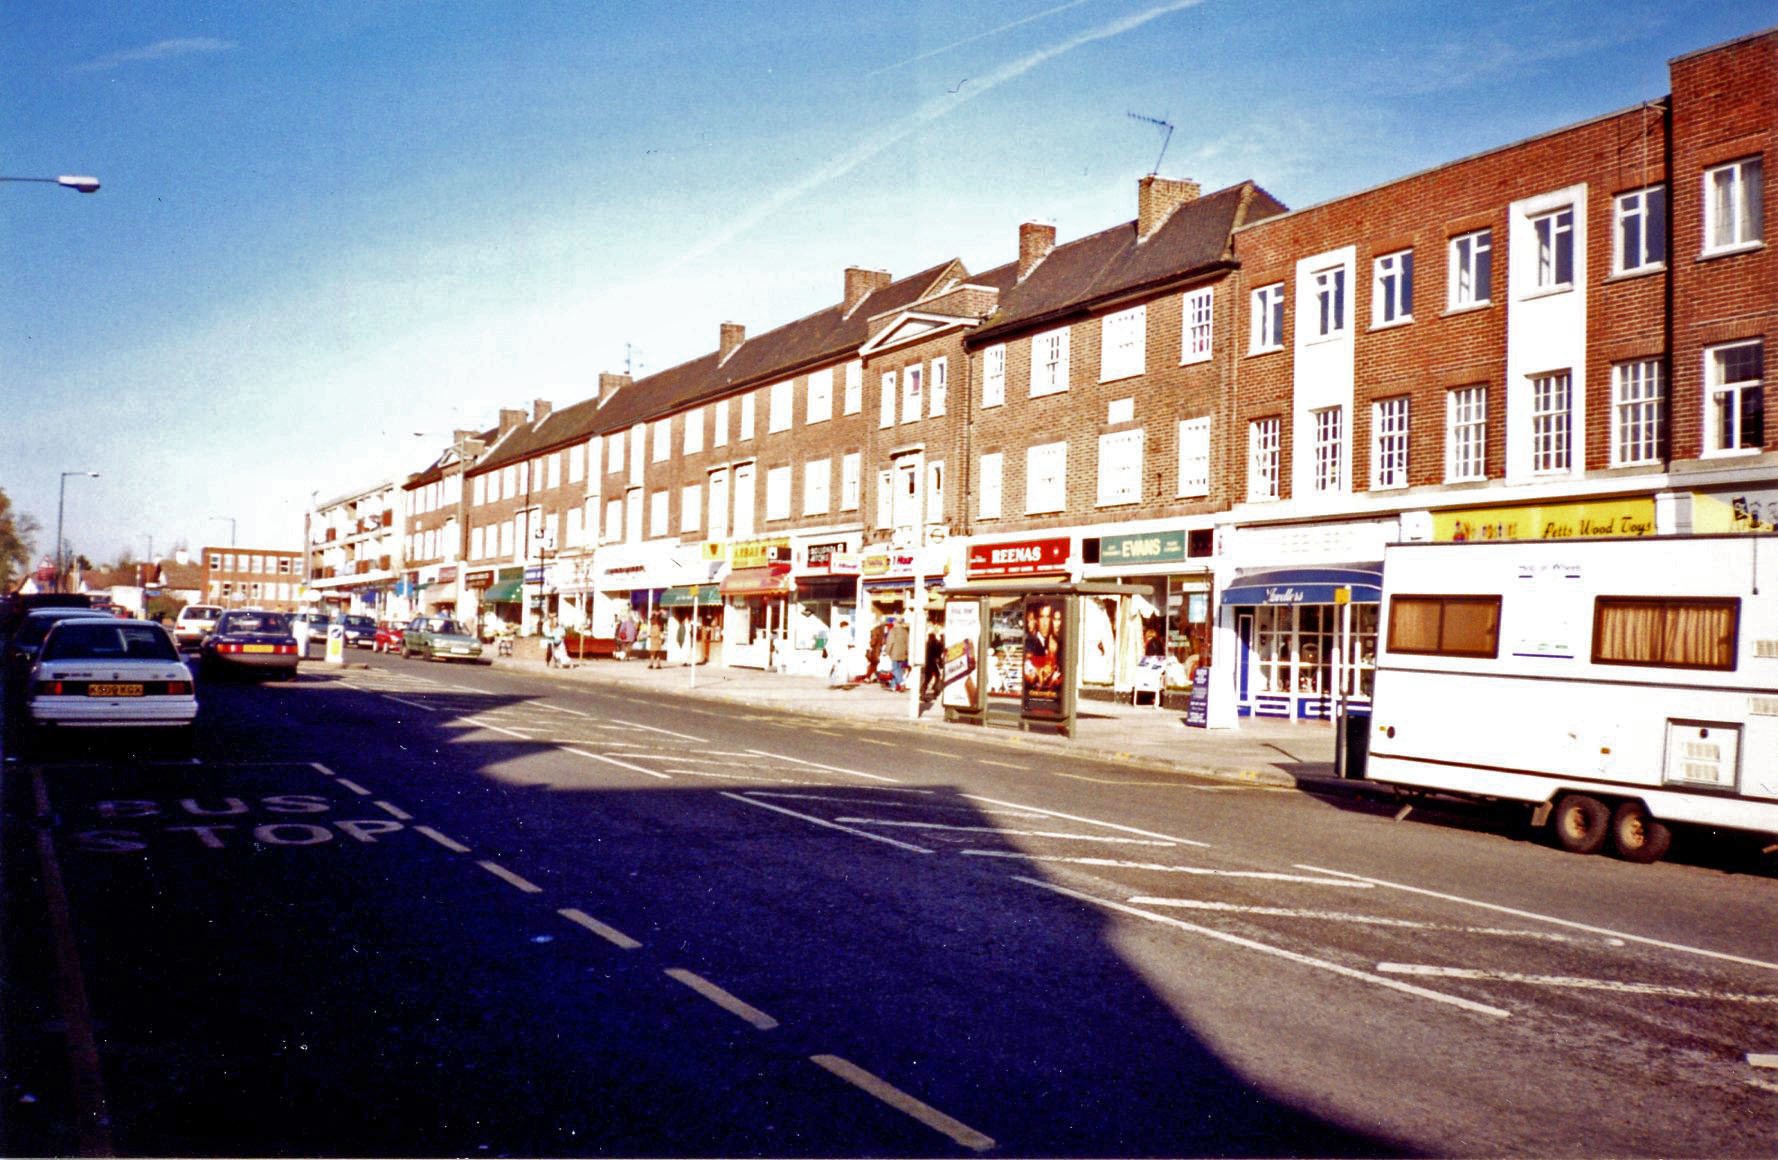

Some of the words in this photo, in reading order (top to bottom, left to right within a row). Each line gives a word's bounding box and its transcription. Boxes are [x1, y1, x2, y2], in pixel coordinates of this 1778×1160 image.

[1543, 522, 1573, 539] Petts
[1580, 519, 1614, 537] Wood
[1620, 516, 1652, 535] Toys
[1122, 538, 1161, 557] EVANS
[97, 795, 331, 817] BUS
[74, 820, 404, 850] STOP
